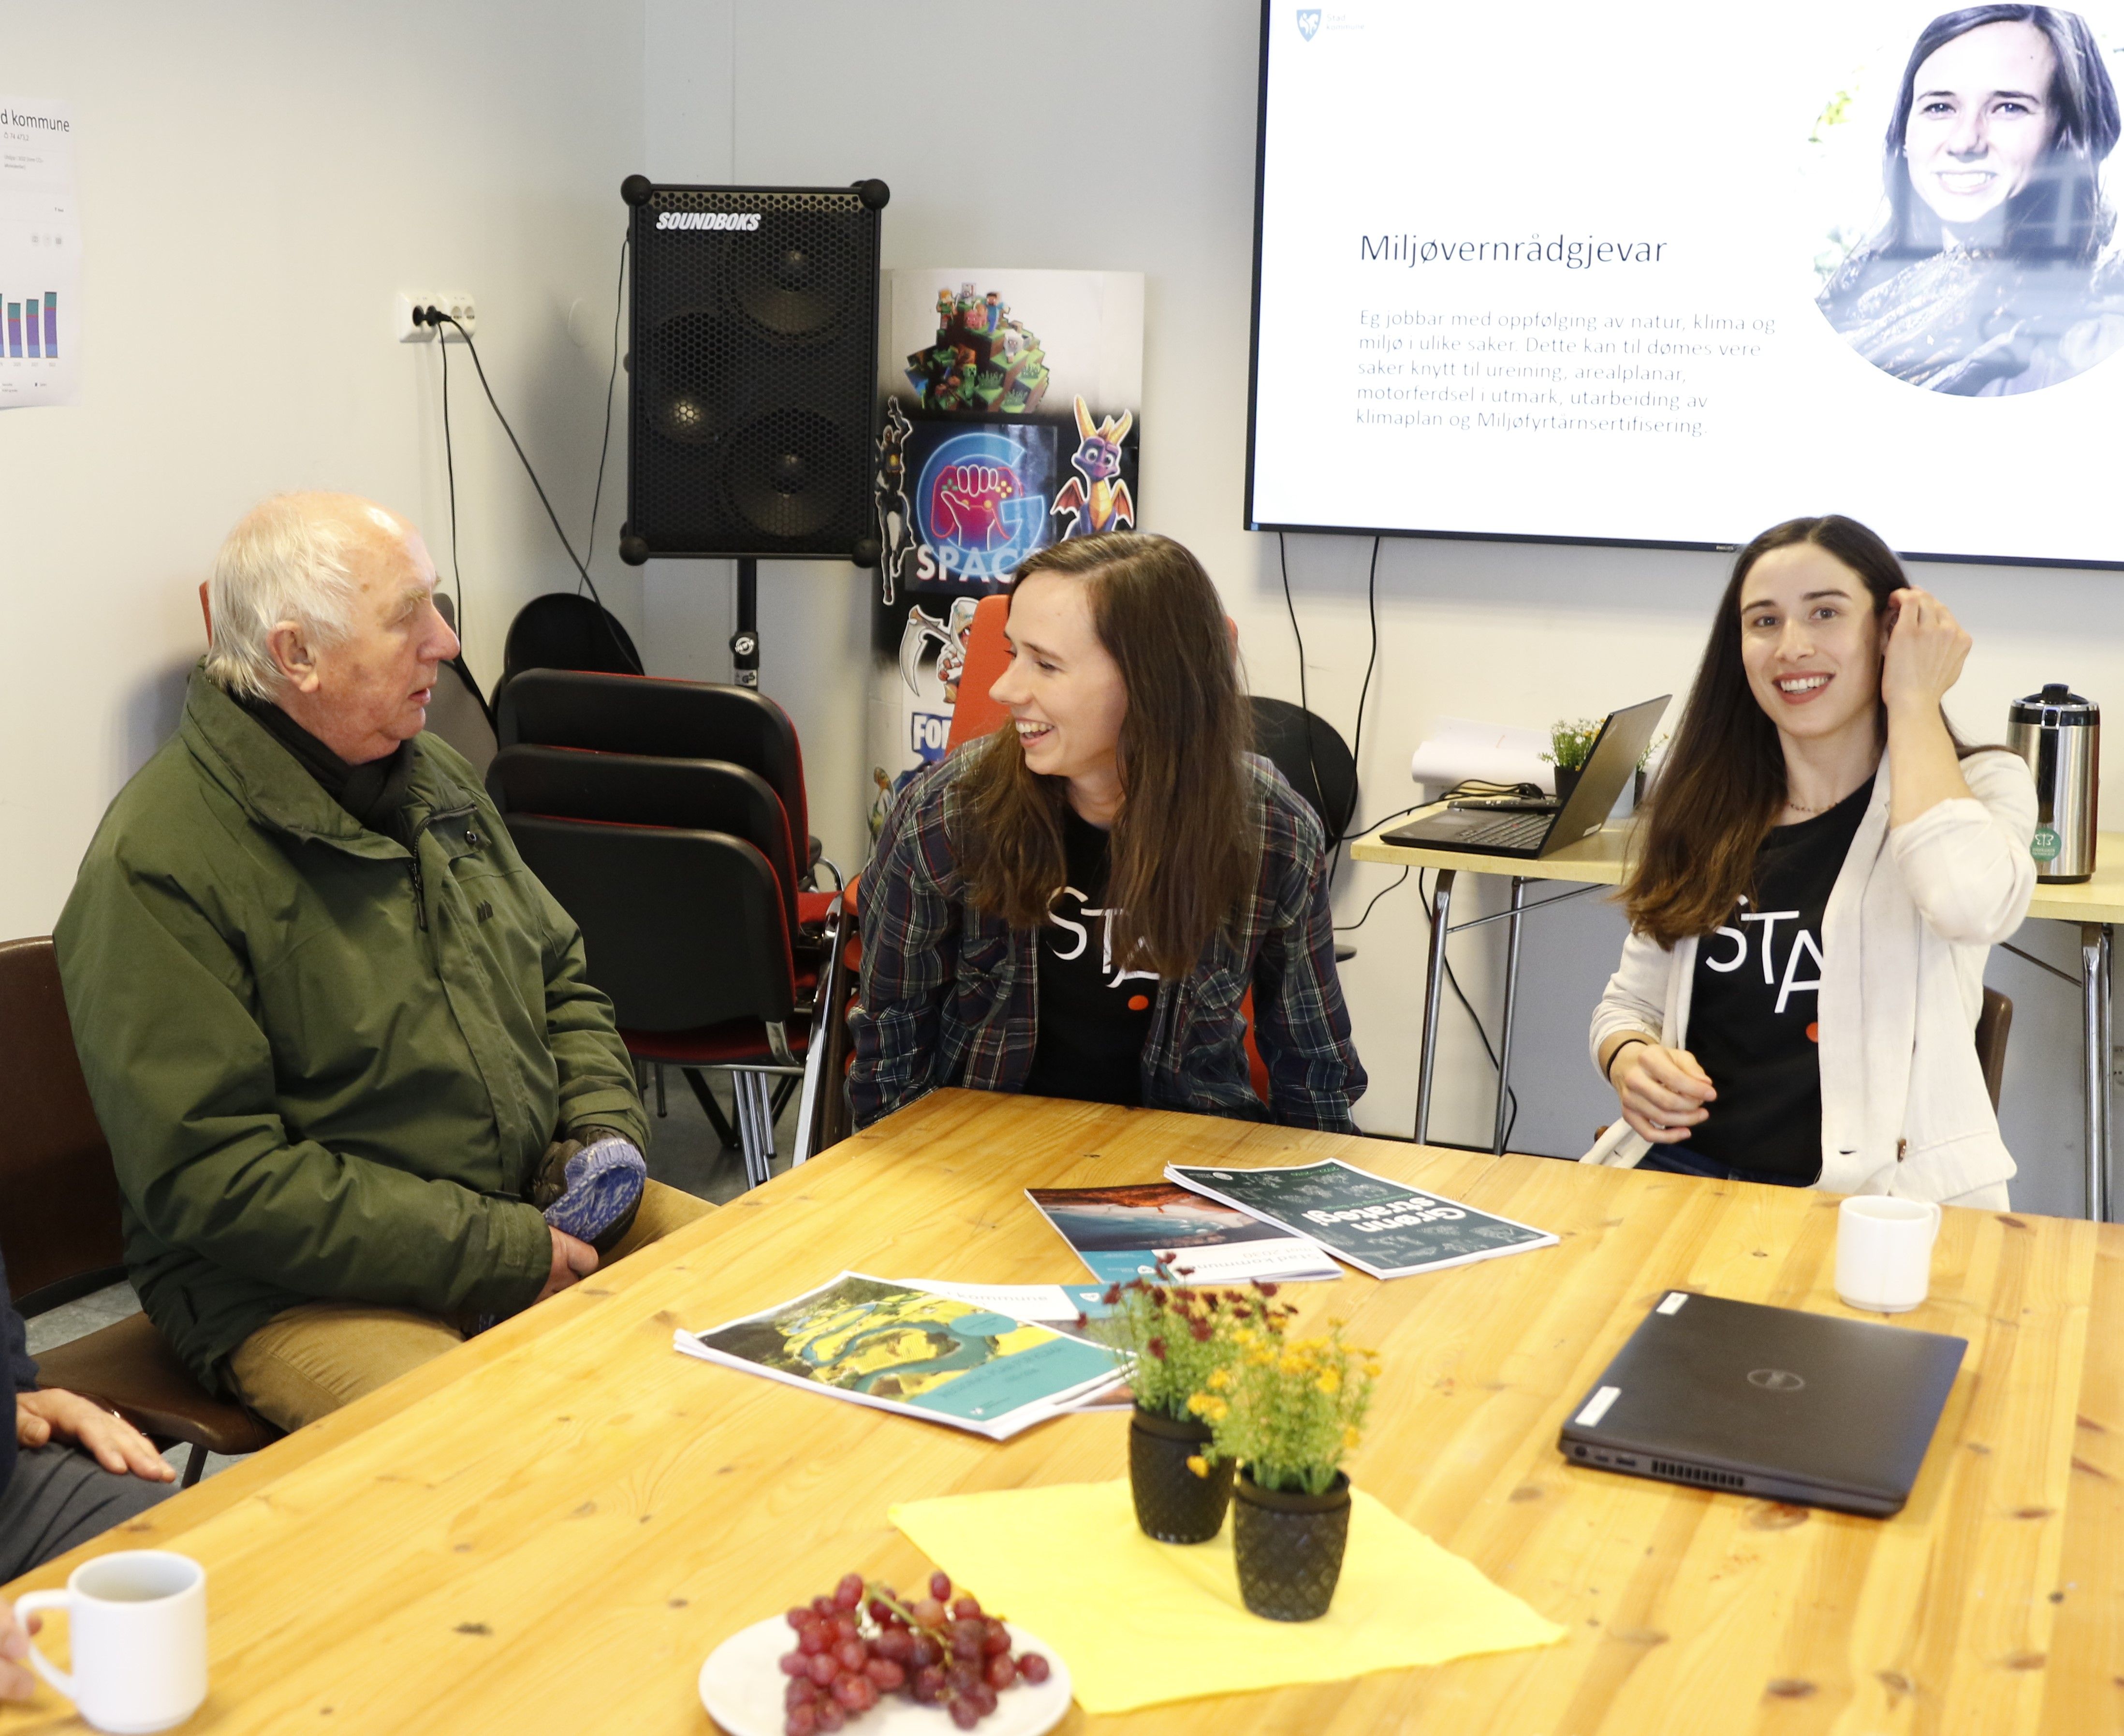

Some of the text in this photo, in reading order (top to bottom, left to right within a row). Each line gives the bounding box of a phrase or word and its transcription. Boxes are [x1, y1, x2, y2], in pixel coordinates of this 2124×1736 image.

[11, 109, 70, 132] kommune
[656, 212, 761, 231] SOUNDBOKS
[1361, 233, 1668, 269] Miljøvernrådgjevar
[1361, 309, 1775, 335] Eg jobbar med oppfølging av natur, klima og
[1360, 334, 1760, 356] miljø i ulike saker. Dette kan til dømes vere
[1359, 360, 1685, 384] saker knytt til ureining, arealplanar,
[1358, 385, 1708, 411] motorferdsel i utmark, utarbeiding av
[1357, 408, 1707, 437] klimaplan og Miljøfyrtårnsertifisering.
[1302, 1196, 1436, 1225] strategi
[1350, 1207, 1467, 1233] Grønn
